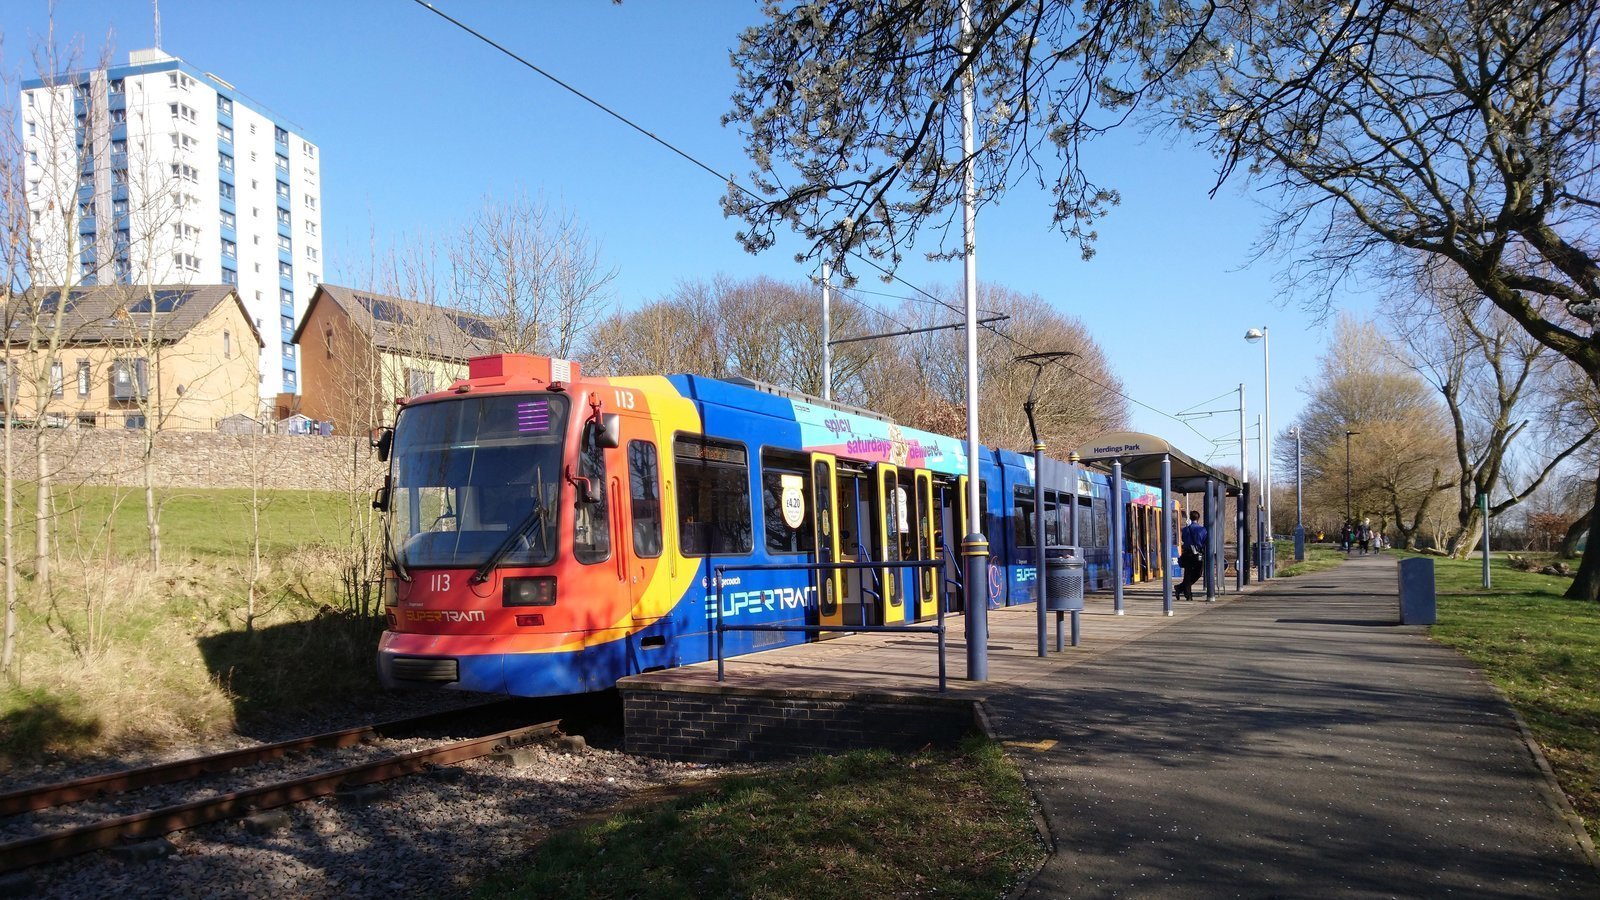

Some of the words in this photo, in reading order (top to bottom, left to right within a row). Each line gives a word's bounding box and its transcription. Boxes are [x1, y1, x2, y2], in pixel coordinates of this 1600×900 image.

[615, 390, 635, 410] 113
[824, 413, 854, 438] spicy
[847, 433, 892, 458] saturdays
[1093, 446, 1123, 454] Herdings
[431, 574, 451, 592] 113
[712, 577, 741, 588] Sgecoach
[406, 610, 485, 622] SUPERTRAM
